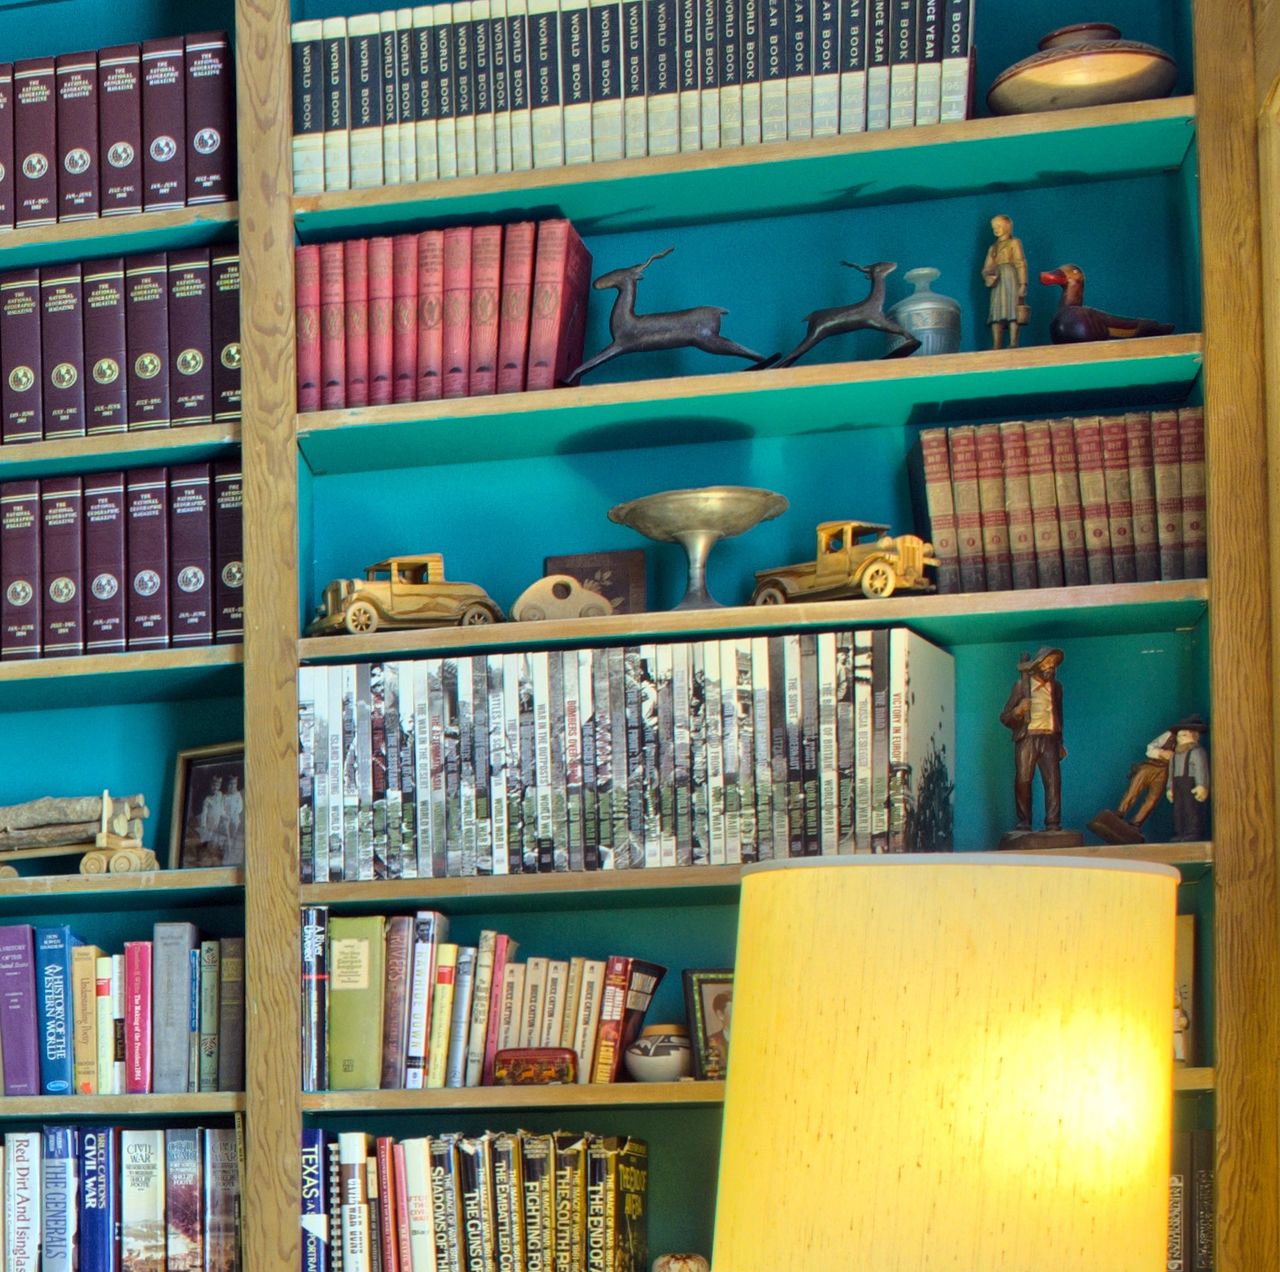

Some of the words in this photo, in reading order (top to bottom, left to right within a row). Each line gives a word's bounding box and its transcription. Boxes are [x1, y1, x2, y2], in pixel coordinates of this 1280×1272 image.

[570, 14, 580, 57] WORLD
[629, 6, 638, 50] WORLD
[684, 0, 693, 43] WORLD
[952, 12, 960, 54] BOOK
[400, 33, 410, 76] WORLD
[439, 29, 448, 72] WORLD
[477, 24, 486, 67] WORLD
[512, 20, 522, 63] WORLD
[769, 38, 778, 76] BOOK
[822, 29, 831, 70] BOOK
[874, 27, 883, 63] YEAR
[927, 23, 935, 59] YEAR
[303, 46, 311, 88] WORLD
[360, 40, 369, 82] WORLD
[629, 57, 638, 92] BOOK
[684, 50, 693, 86] BOOK
[726, 45, 734, 81] BOOK
[439, 80, 448, 114] BOOK
[477, 74, 486, 109] BOOK
[512, 70, 522, 106] BOOK
[570, 64, 580, 100] BOOK
[303, 95, 311, 129] BOOK
[360, 89, 369, 124] BOOK
[400, 84, 410, 118] BOOK
[567, 700, 577, 736] BOMBERS
[789, 694, 798, 718] SOVIET
[892, 692, 902, 723] VICTORY
[824, 738, 834, 768] BRITAIN
[540, 794, 550, 821] WORLD
[825, 778, 834, 805] WORLD
[859, 776, 869, 804] WORLD
[825, 808, 834, 826] WAR
[860, 806, 869, 824] WAR
[388, 934, 406, 981] RIVERS
[45, 964, 56, 1016] WESTERN
[414, 951, 426, 1003] RAWHIDE
[54, 975, 65, 1020] HISTORY
[77, 978, 93, 1024] Understanding
[504, 1001, 514, 1026] CATTON
[548, 996, 556, 1018] CATTON
[582, 1000, 592, 1026] CATTON
[411, 1012, 424, 1048] DOWN
[528, 1004, 538, 1028] CATTON
[46, 1020, 56, 1060] WORLD
[15, 1139, 31, 1162] Red
[85, 1133, 97, 1176] CIVIL
[127, 1143, 154, 1155] CIVIL
[130, 1153, 151, 1163] WAR
[16, 1167, 30, 1191] Dirt
[46, 1162, 67, 1189] THE
[302, 1144, 320, 1199] TEXAS
[495, 1160, 508, 1184] THE
[556, 1166, 570, 1200] THE
[16, 1193, 31, 1222] And
[85, 1178, 97, 1210] WAR
[430, 1166, 445, 1232] SHADOWS
[464, 1188, 480, 1219] THE
[571, 1189, 580, 1215] IMAGE
[588, 1182, 604, 1214] THE
[45, 1192, 67, 1260] GENERALS
[496, 1184, 510, 1253] EMBATTLED
[525, 1182, 540, 1250] FIGHTING
[556, 1200, 570, 1250] SOUTH
[588, 1216, 603, 1248] END
[434, 1232, 446, 1248] OF
[466, 1220, 482, 1257] GUNS
[589, 1249, 603, 1267] OF
